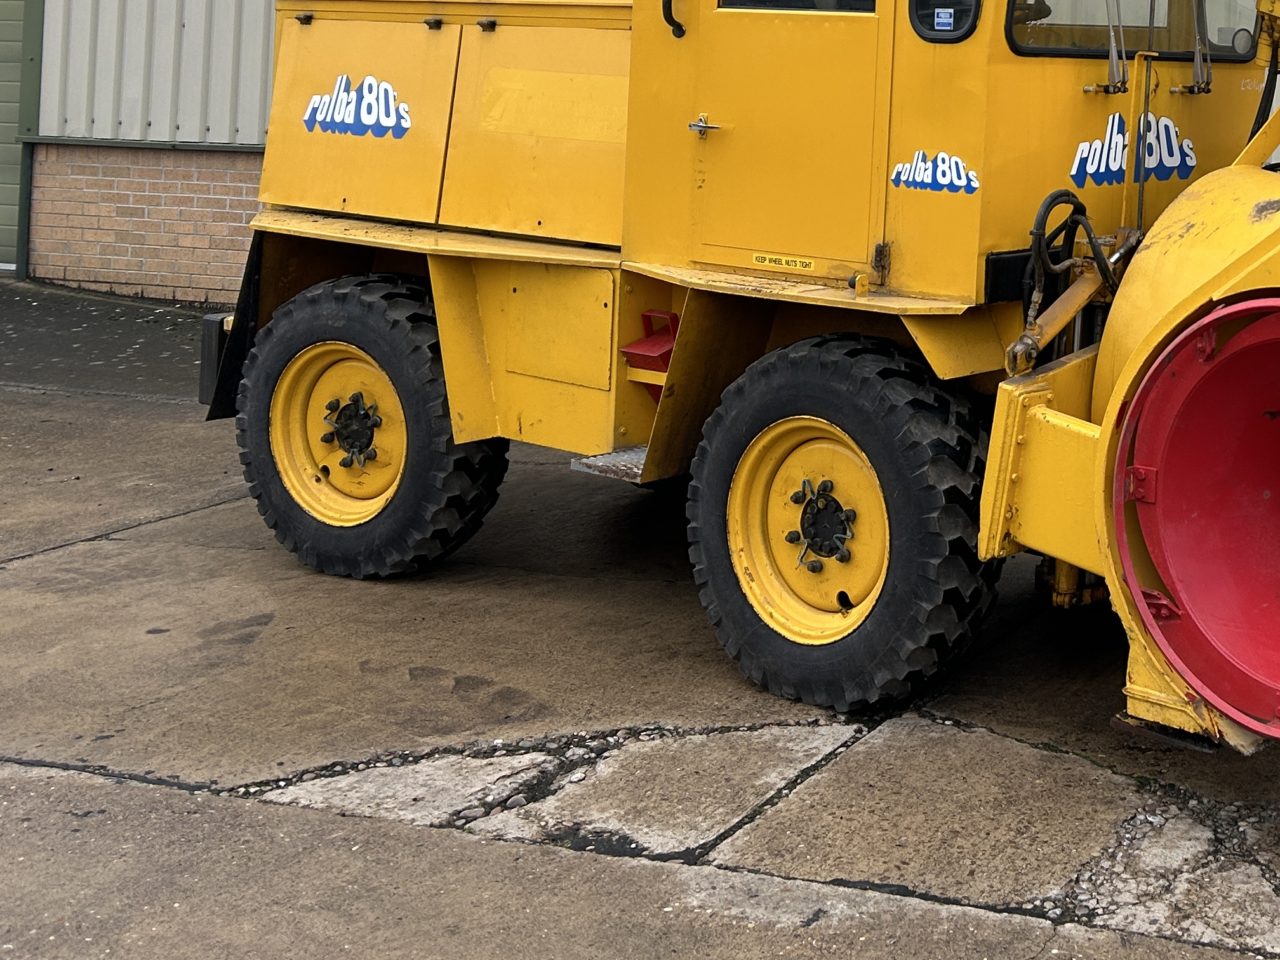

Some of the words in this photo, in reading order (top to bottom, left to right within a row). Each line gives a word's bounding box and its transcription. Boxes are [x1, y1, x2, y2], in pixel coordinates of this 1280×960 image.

[303, 73, 358, 130] rolba
[891, 150, 934, 185] rolba
[755, 255, 767, 264] KEEP
[768, 257, 784, 266] WHEEL
[785, 259, 797, 268] NUTS
[799, 260, 812, 269] TIGHT
